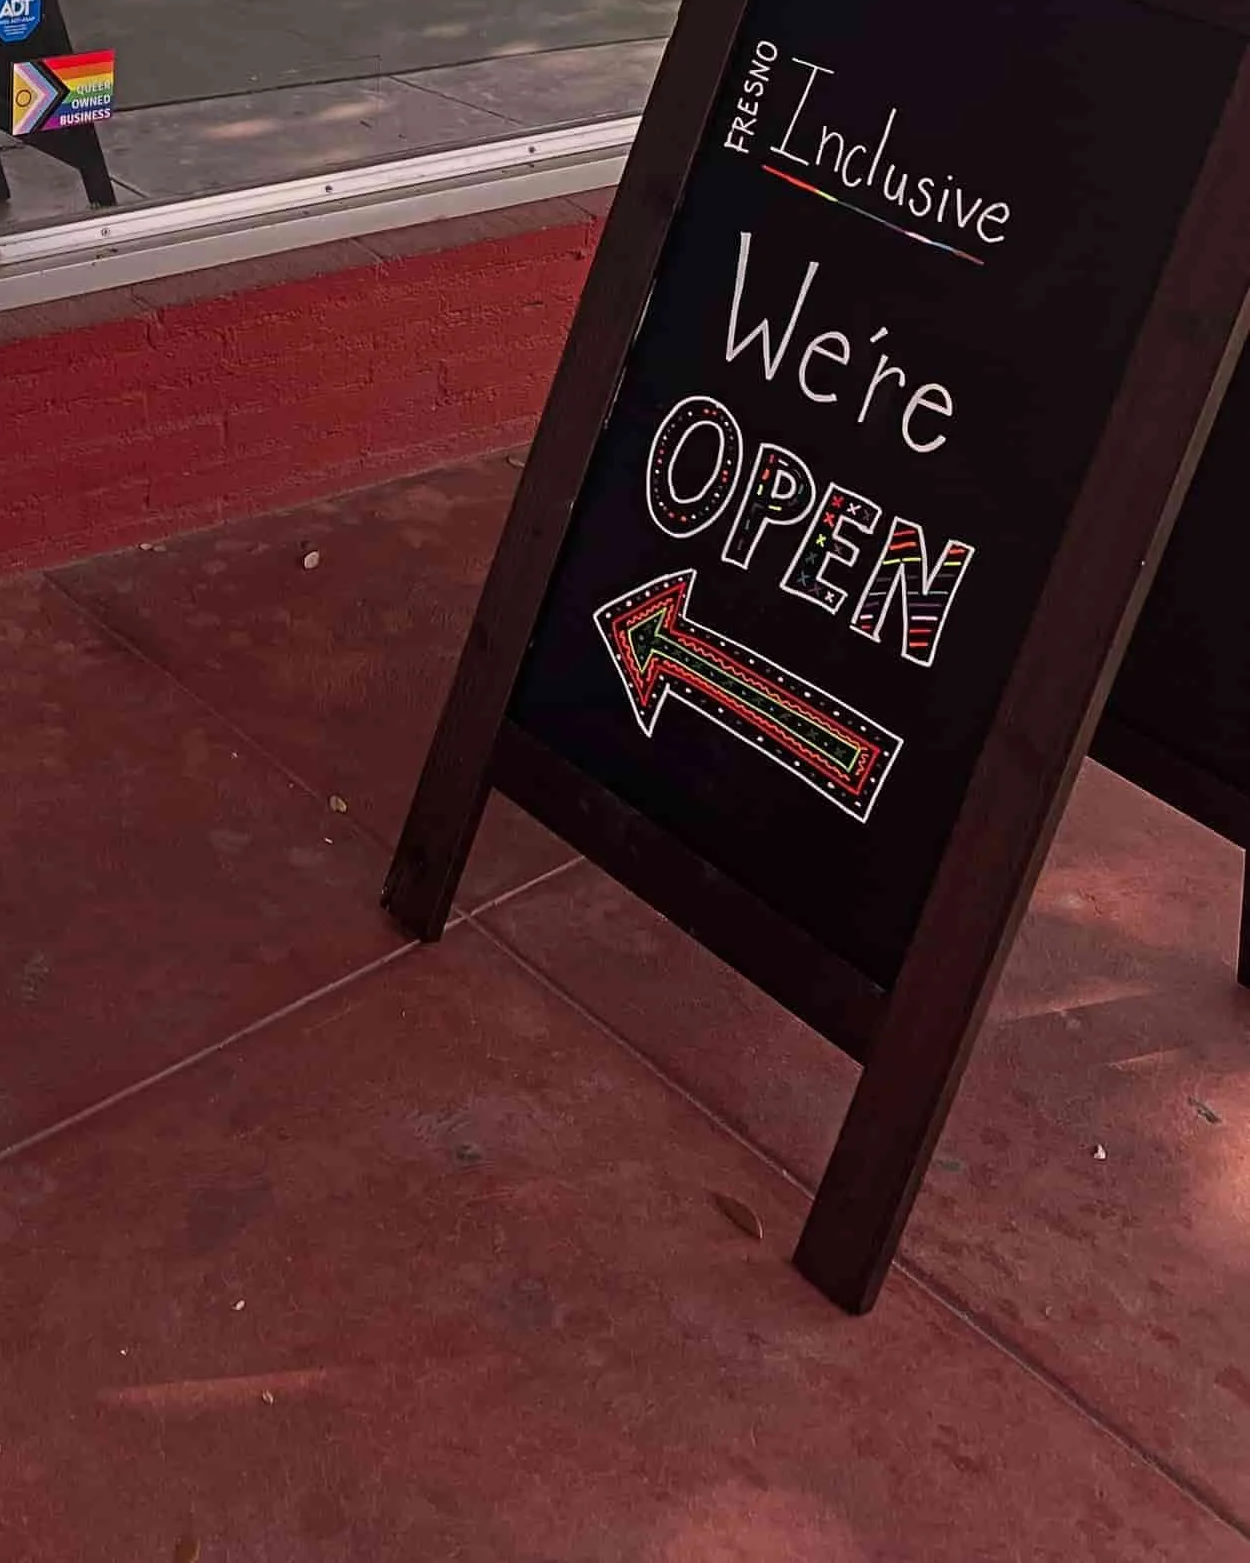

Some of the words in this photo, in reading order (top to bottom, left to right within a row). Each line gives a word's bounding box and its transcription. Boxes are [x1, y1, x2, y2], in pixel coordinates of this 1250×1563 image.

[59, 108, 111, 126] BUSINESS
[71, 94, 111, 110] OWNED
[724, 40, 778, 154] FRESNO
[769, 57, 1011, 244] Inclusive
[725, 232, 954, 454] We're
[646, 396, 975, 667] OPEN
